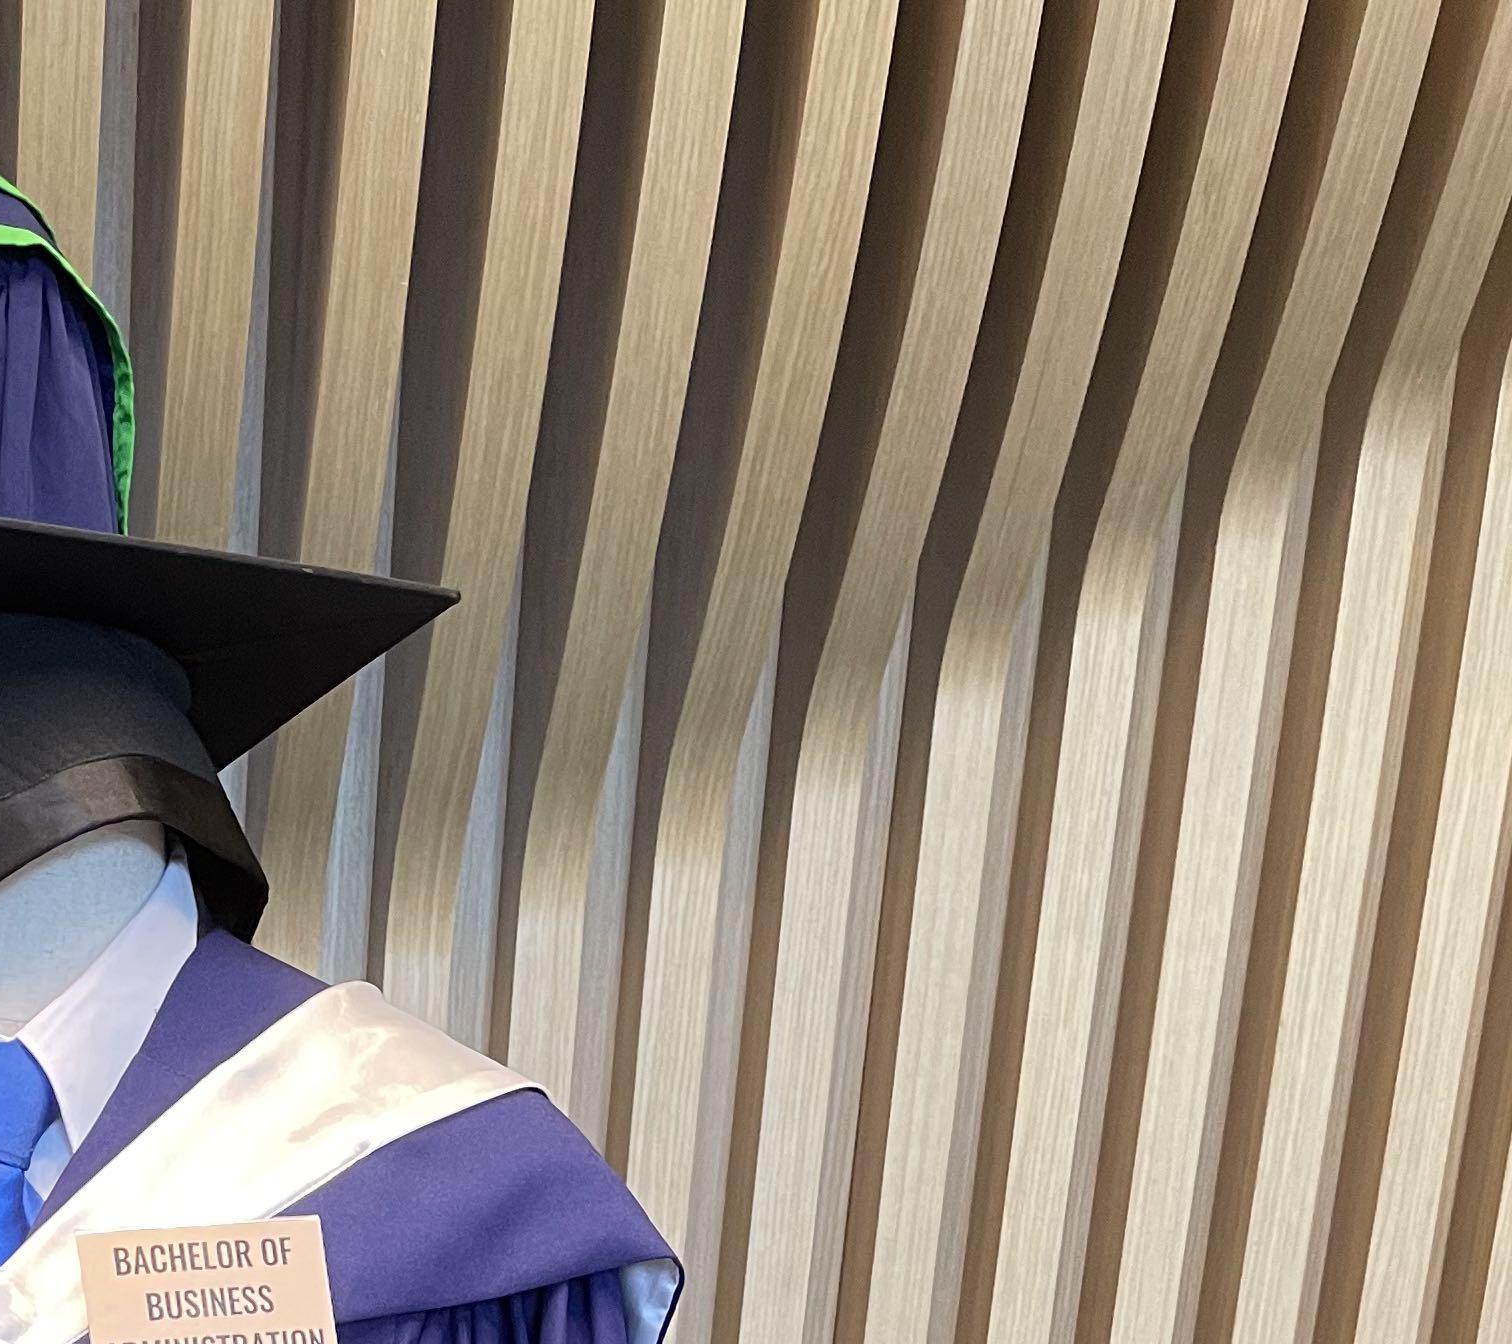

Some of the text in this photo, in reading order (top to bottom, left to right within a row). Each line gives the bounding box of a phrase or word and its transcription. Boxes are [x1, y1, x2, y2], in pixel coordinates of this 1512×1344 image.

[113, 1237, 291, 1276] BACHELOR OF
[145, 1285, 275, 1321] BUSINESS
